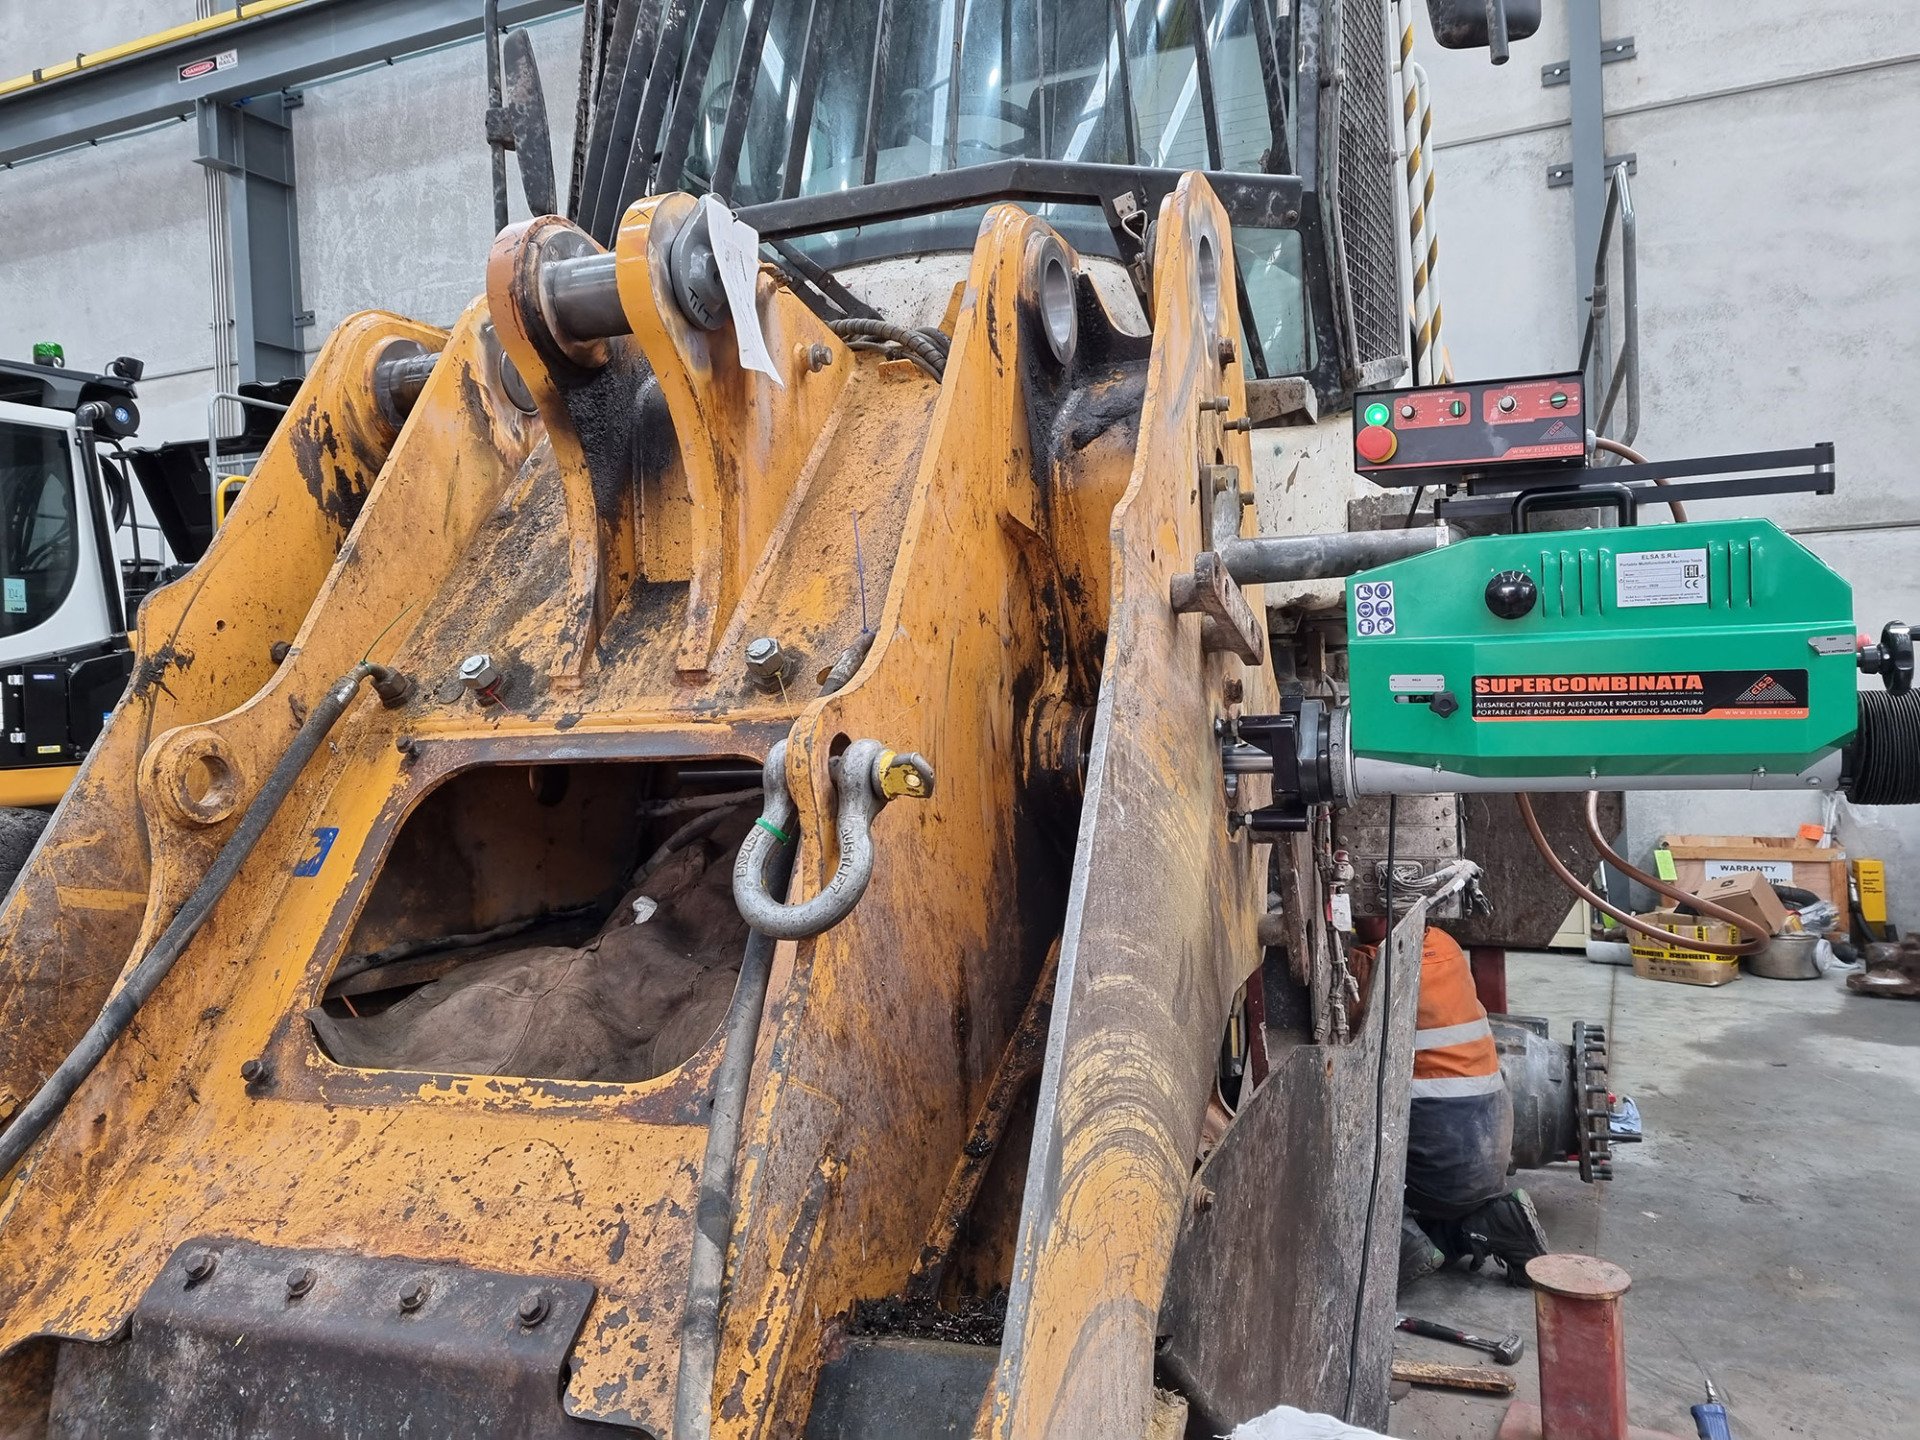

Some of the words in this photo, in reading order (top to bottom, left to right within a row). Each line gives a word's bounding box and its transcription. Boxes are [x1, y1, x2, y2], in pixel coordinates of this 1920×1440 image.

[185, 63, 212, 74] DANGER
[1475, 675, 1704, 693] SUPERCOMBINATA
[1751, 676, 1774, 695] elsa
[1567, 700, 1607, 708] ALESATURA
[1719, 864, 1777, 872] WARRANTY
